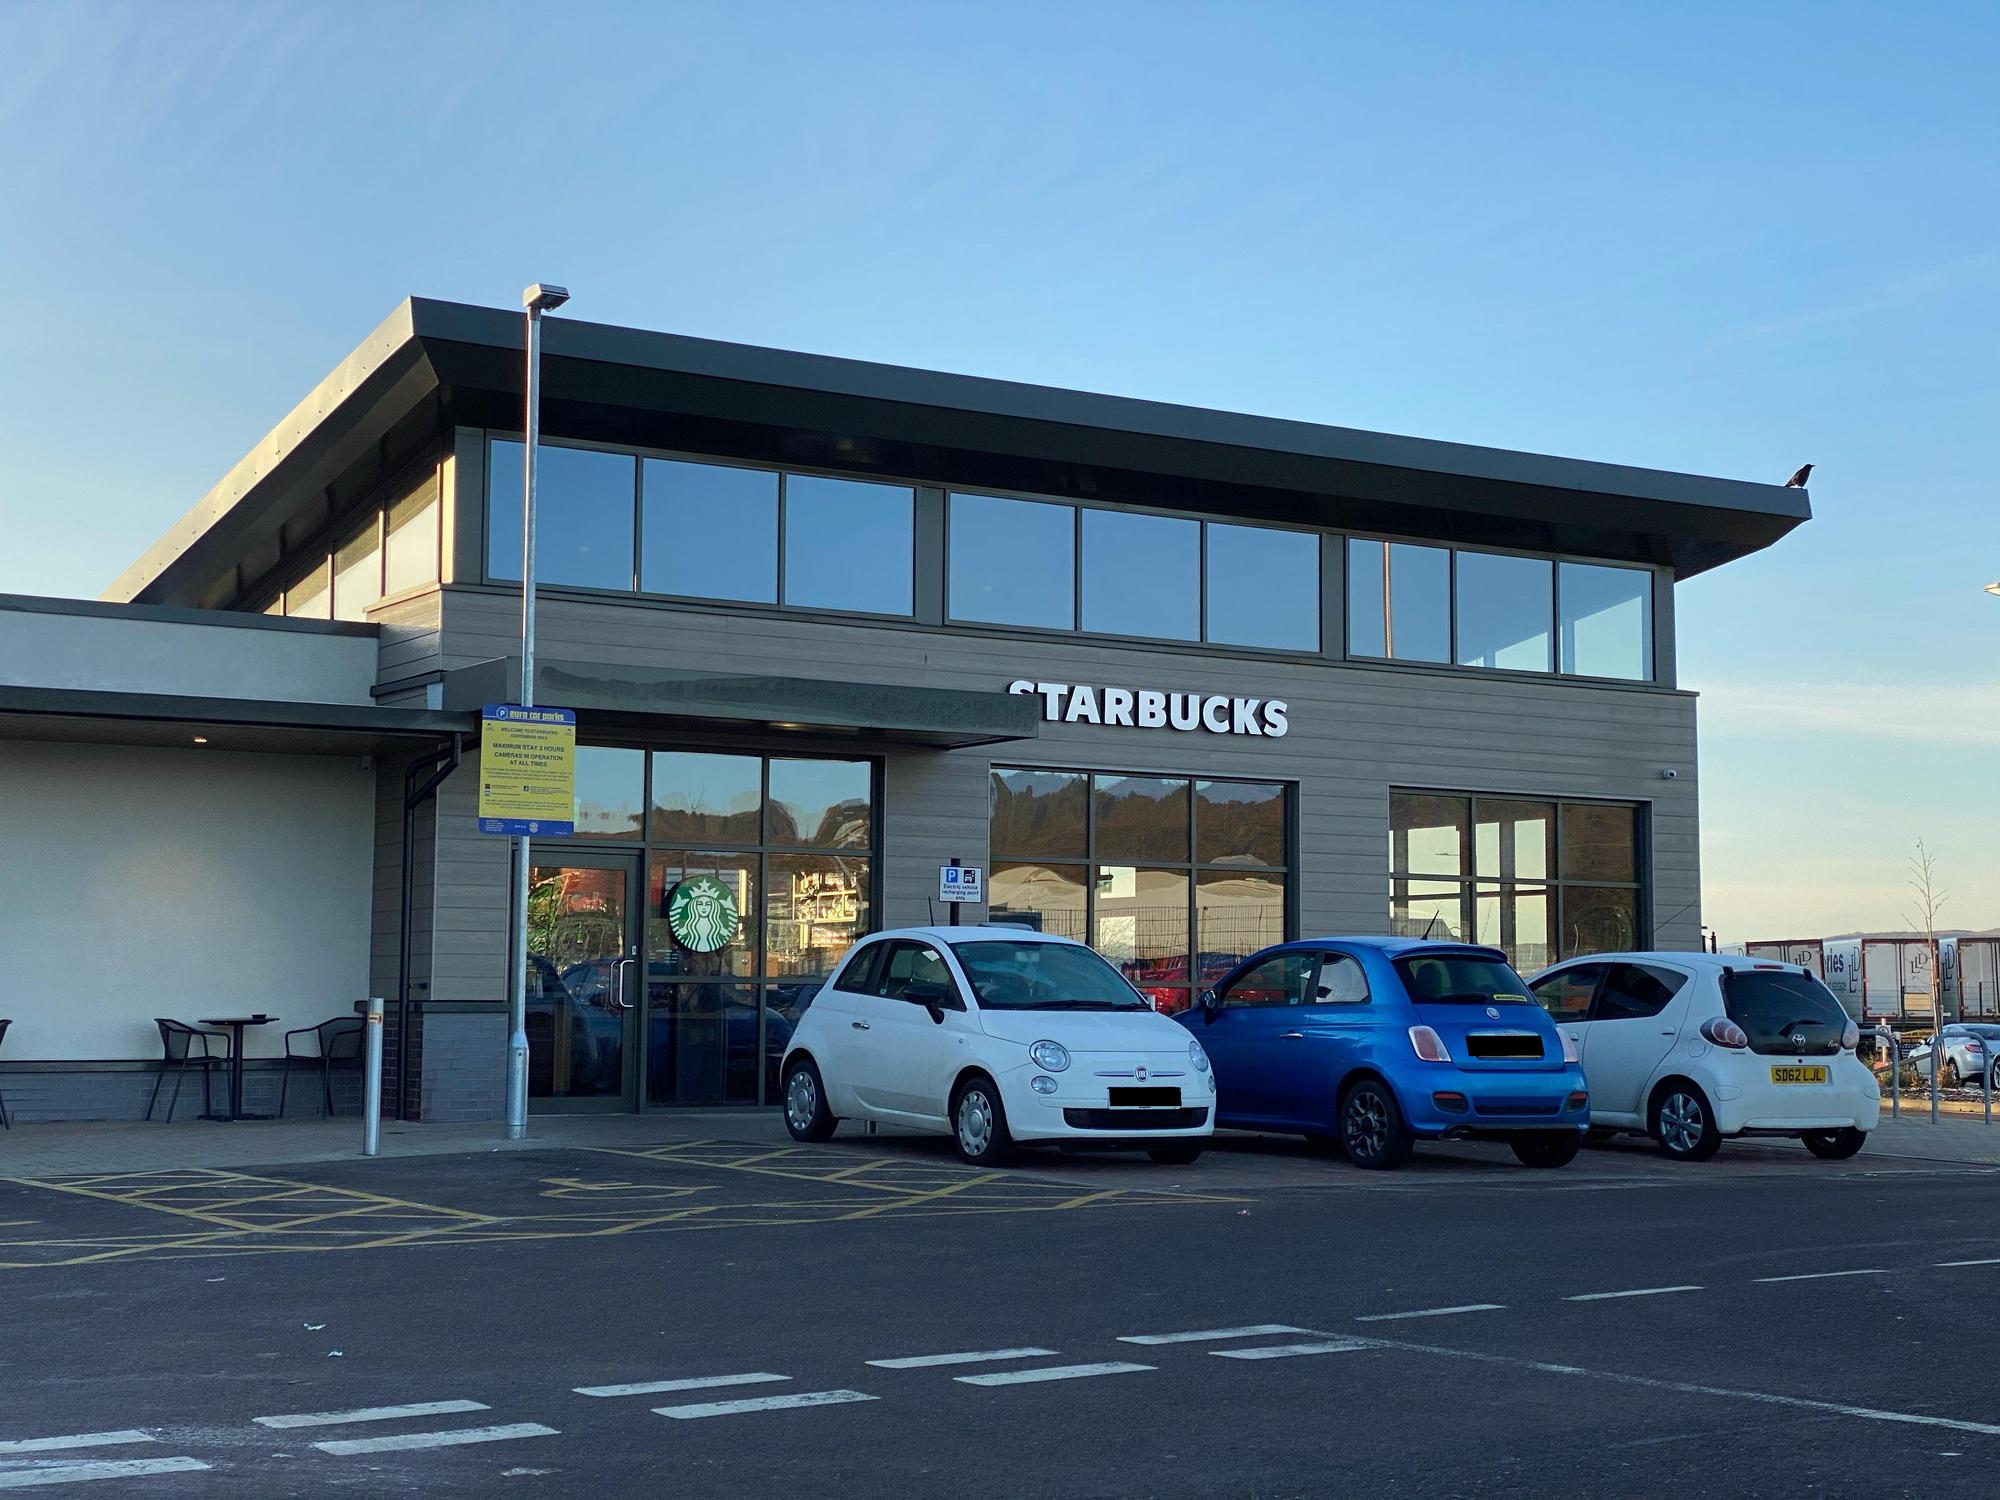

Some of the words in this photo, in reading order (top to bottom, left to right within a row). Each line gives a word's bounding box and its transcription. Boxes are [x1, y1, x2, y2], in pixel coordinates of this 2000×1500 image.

[493, 742, 521, 750] MAXIMUM
[948, 870, 956, 882] P
[1825, 947, 1844, 973] ries
[1775, 1068, 1800, 1081] SD62
[1803, 1068, 1822, 1081] LJL
